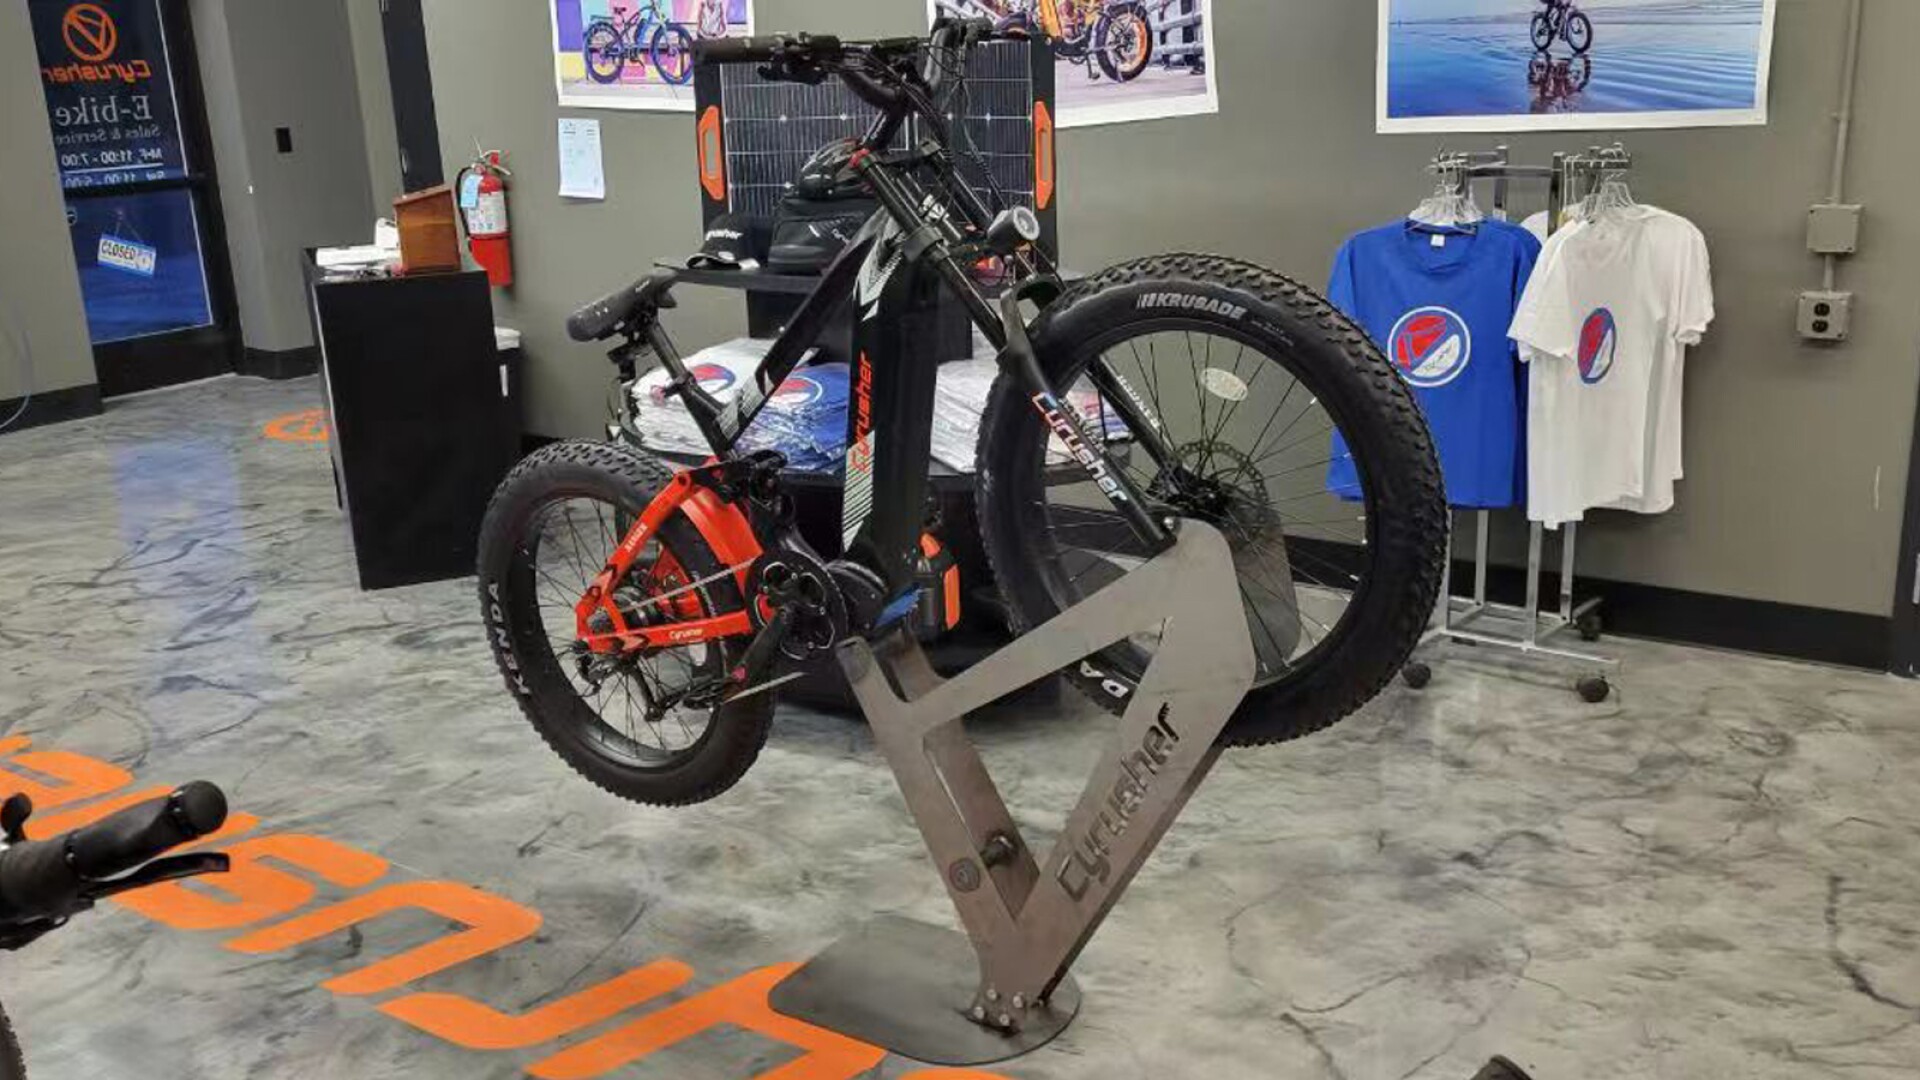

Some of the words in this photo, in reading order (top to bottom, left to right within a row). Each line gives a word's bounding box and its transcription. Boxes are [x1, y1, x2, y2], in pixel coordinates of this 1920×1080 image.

[102, 240, 137, 260] CLOSED
[1156, 293, 1248, 320] KRUSADE
[487, 582, 531, 695] KENDA
[1056, 701, 1180, 903] Cyrusher
